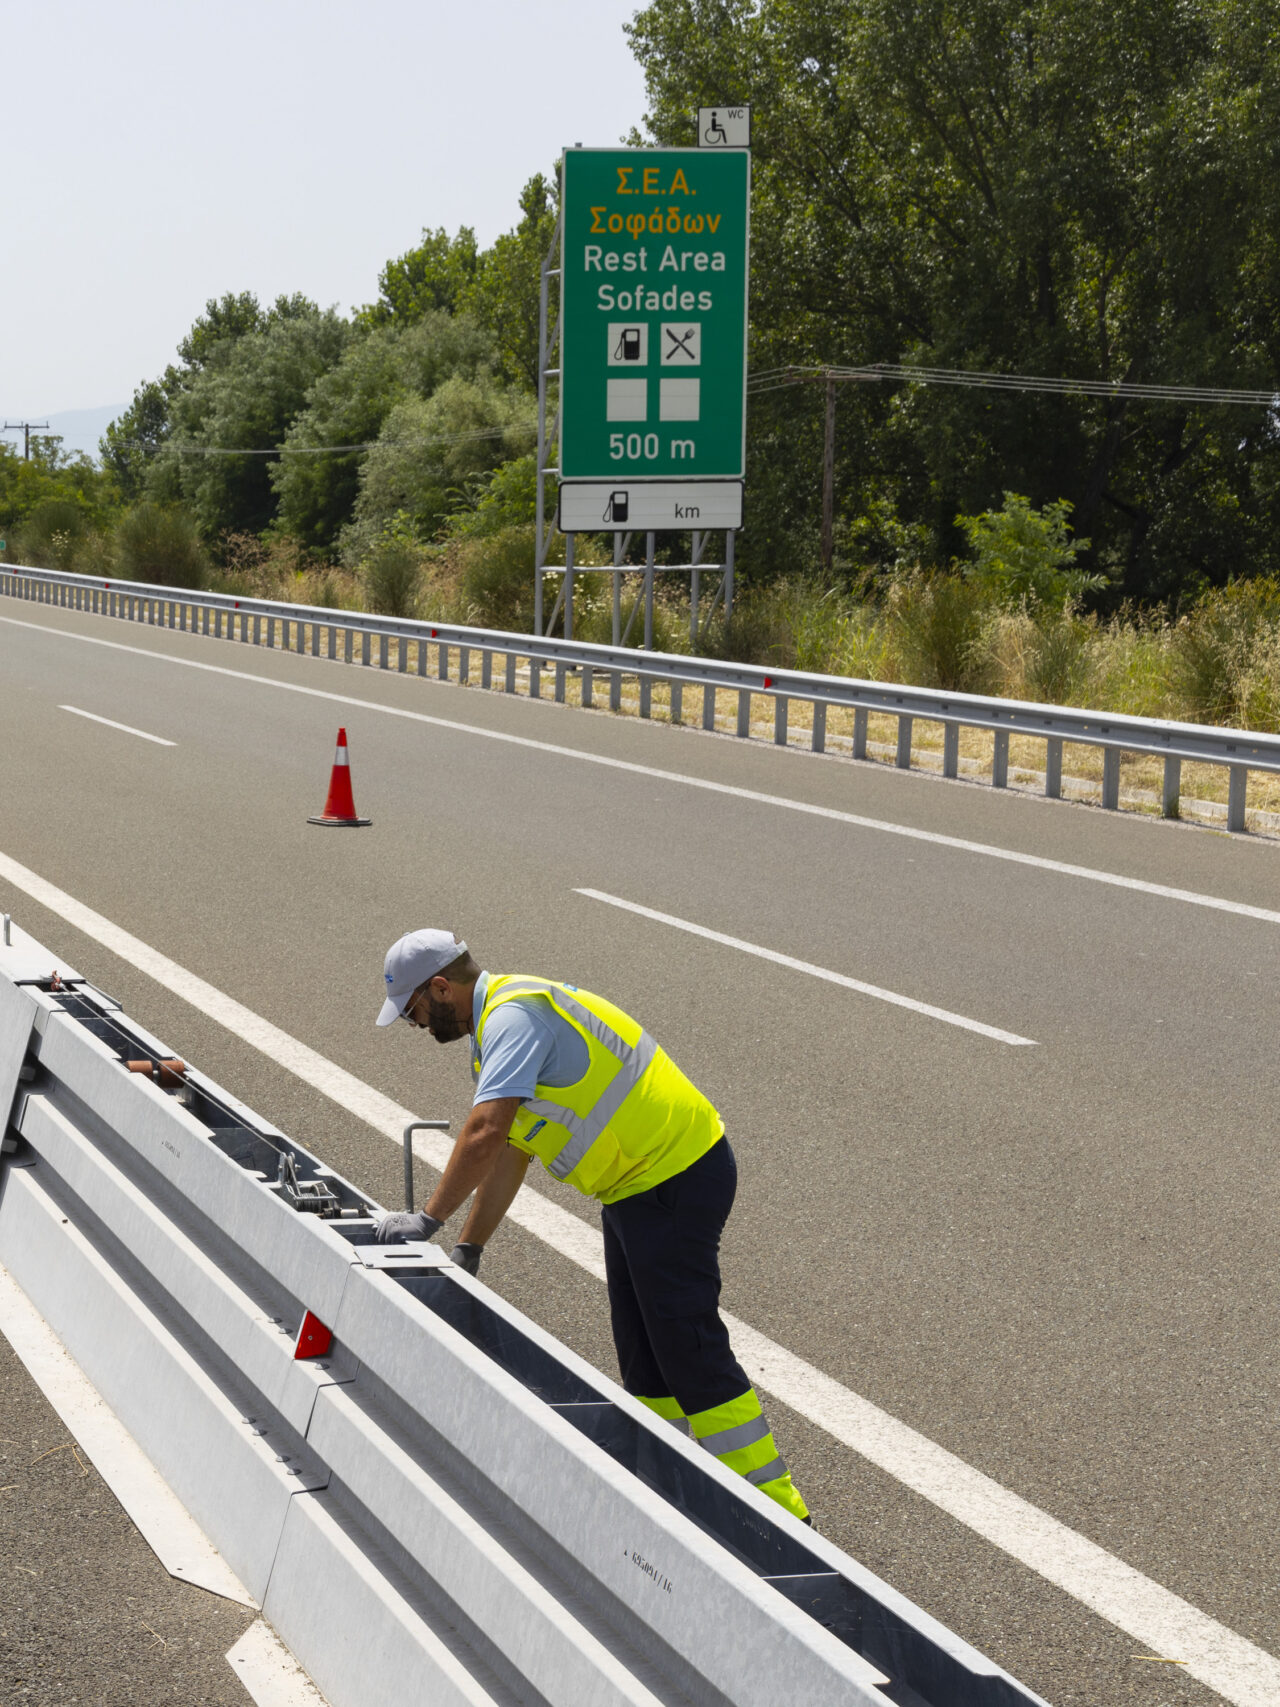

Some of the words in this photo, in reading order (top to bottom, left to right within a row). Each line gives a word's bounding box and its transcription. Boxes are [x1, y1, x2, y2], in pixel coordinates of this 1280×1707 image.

[727, 109, 744, 119] WC
[616, 168, 697, 195] Σ.Ε.Α.
[590, 207, 721, 240] Σοφάδων
[584, 246, 648, 272] Rest
[658, 246, 726, 272] Area
[597, 285, 713, 311] Sofades
[609, 434, 659, 460] 500
[670, 440, 696, 459] m
[674, 503, 700, 519] km
